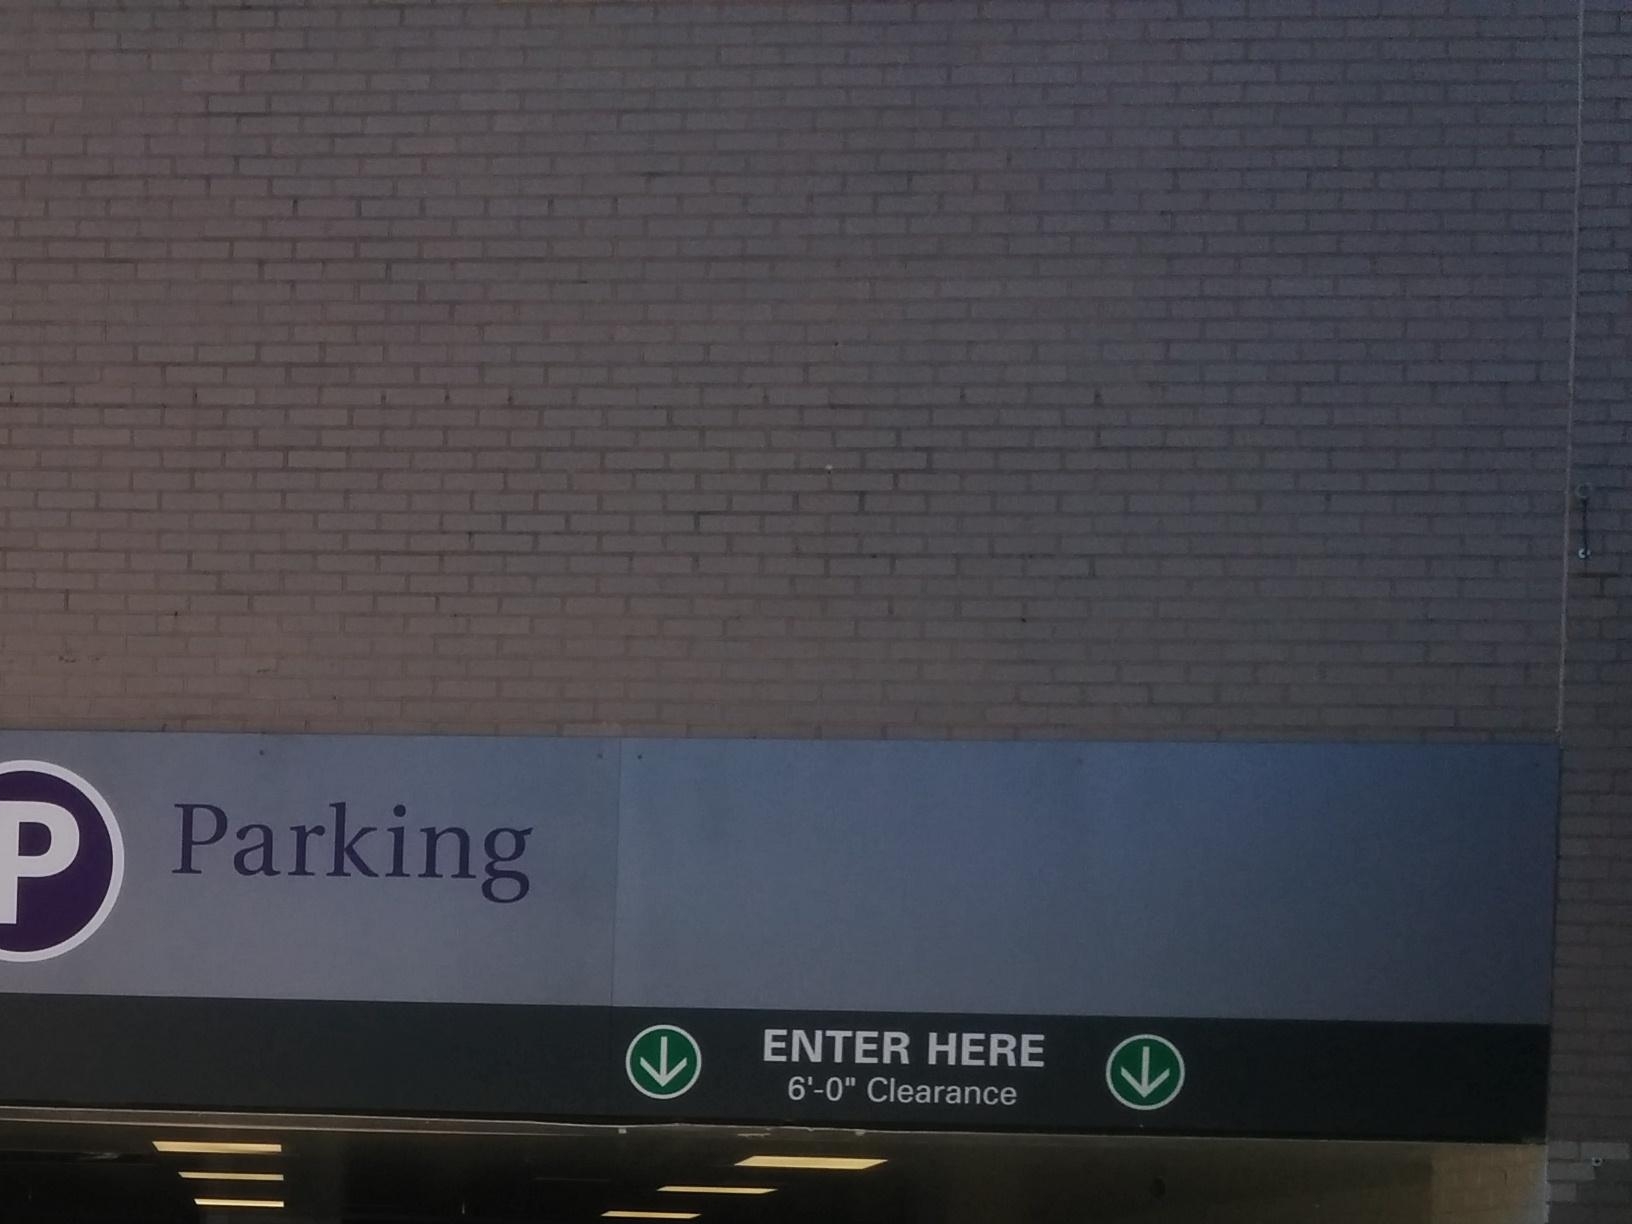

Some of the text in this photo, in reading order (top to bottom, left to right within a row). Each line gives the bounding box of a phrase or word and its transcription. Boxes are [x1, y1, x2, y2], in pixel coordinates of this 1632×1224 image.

[172, 802, 533, 903] Parking
[762, 1029, 1045, 1068] ENTER HERE
[867, 1078, 1018, 1105] Clearance
